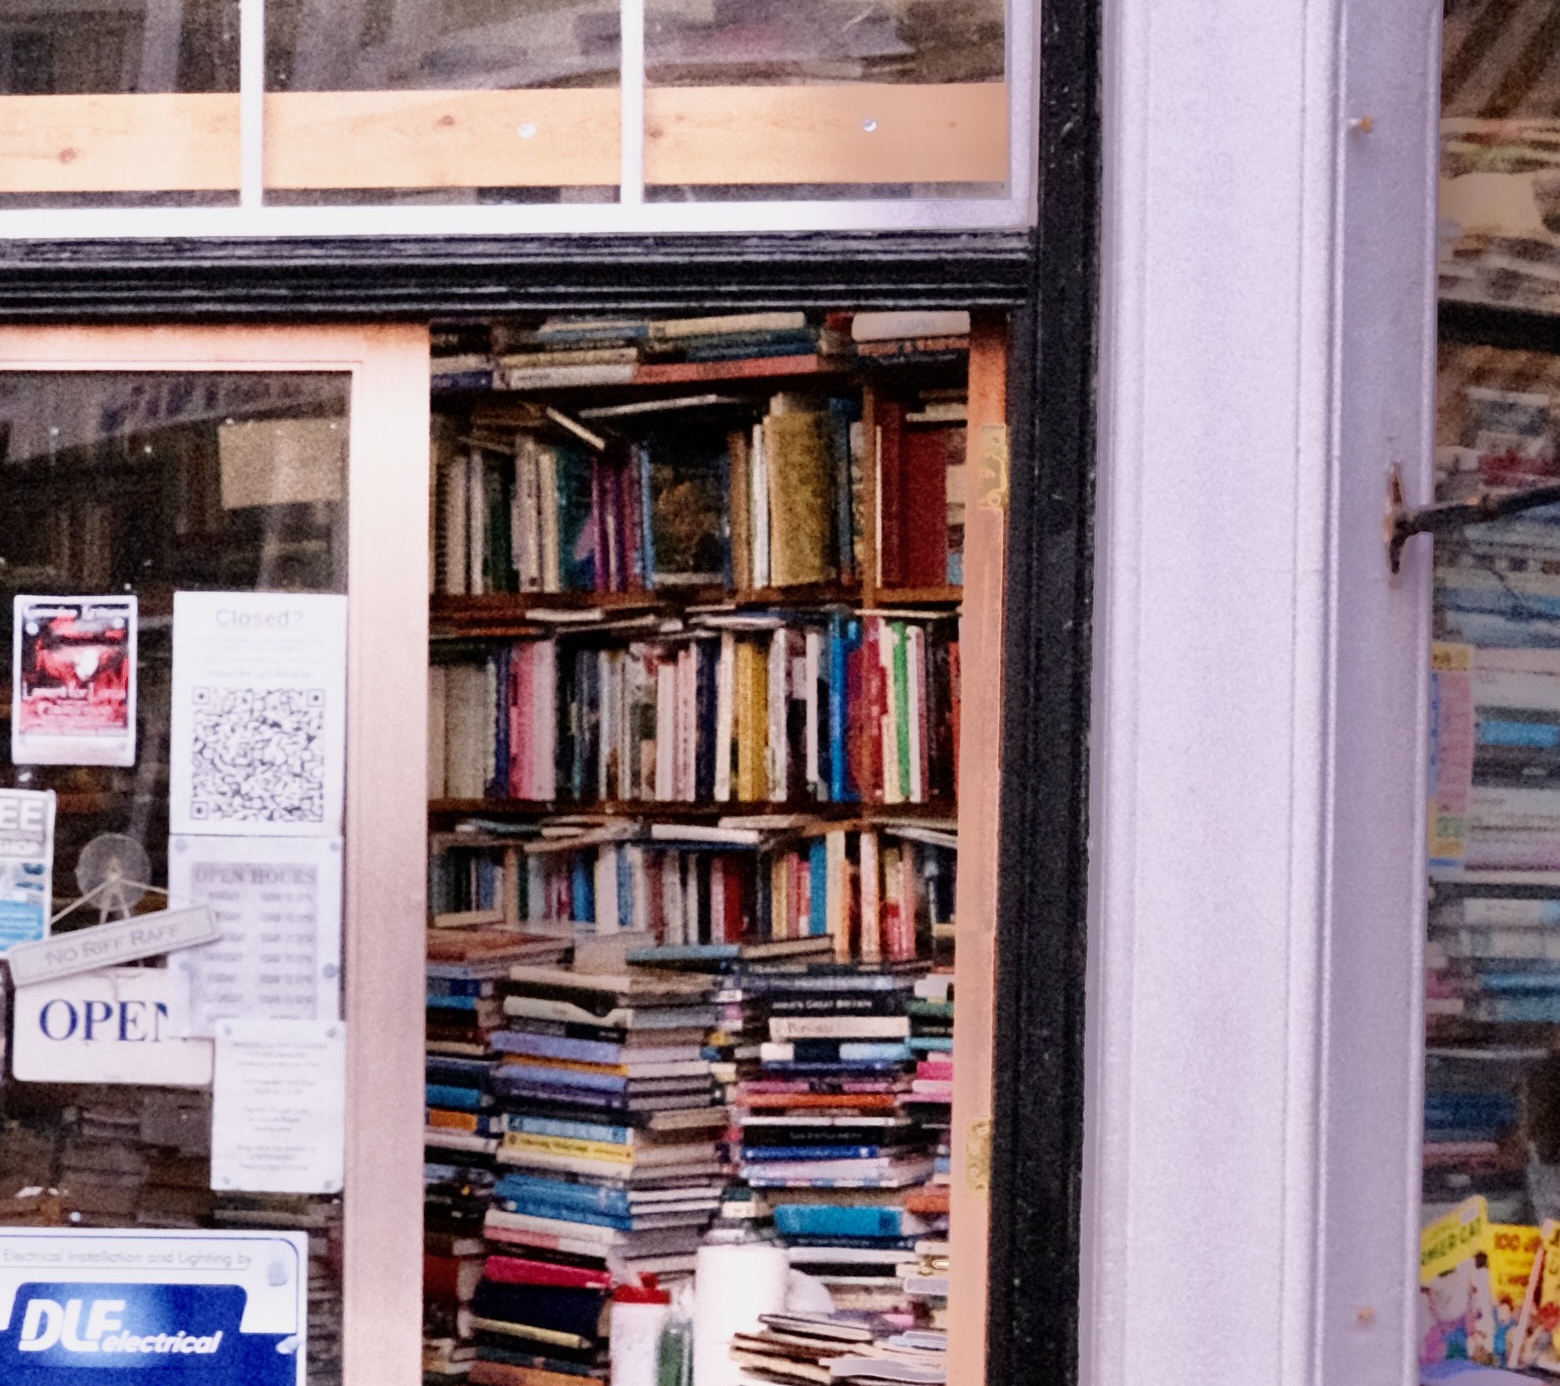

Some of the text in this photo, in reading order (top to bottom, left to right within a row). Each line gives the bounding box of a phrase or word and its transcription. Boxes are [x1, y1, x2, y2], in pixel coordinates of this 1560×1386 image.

[215, 609, 304, 628] Closed?
[46, 922, 179, 965] NO RIFF RAFF
[3, 1250, 251, 1268] Electrical Installation and Lighting by
[101, 1330, 223, 1355] electrical
